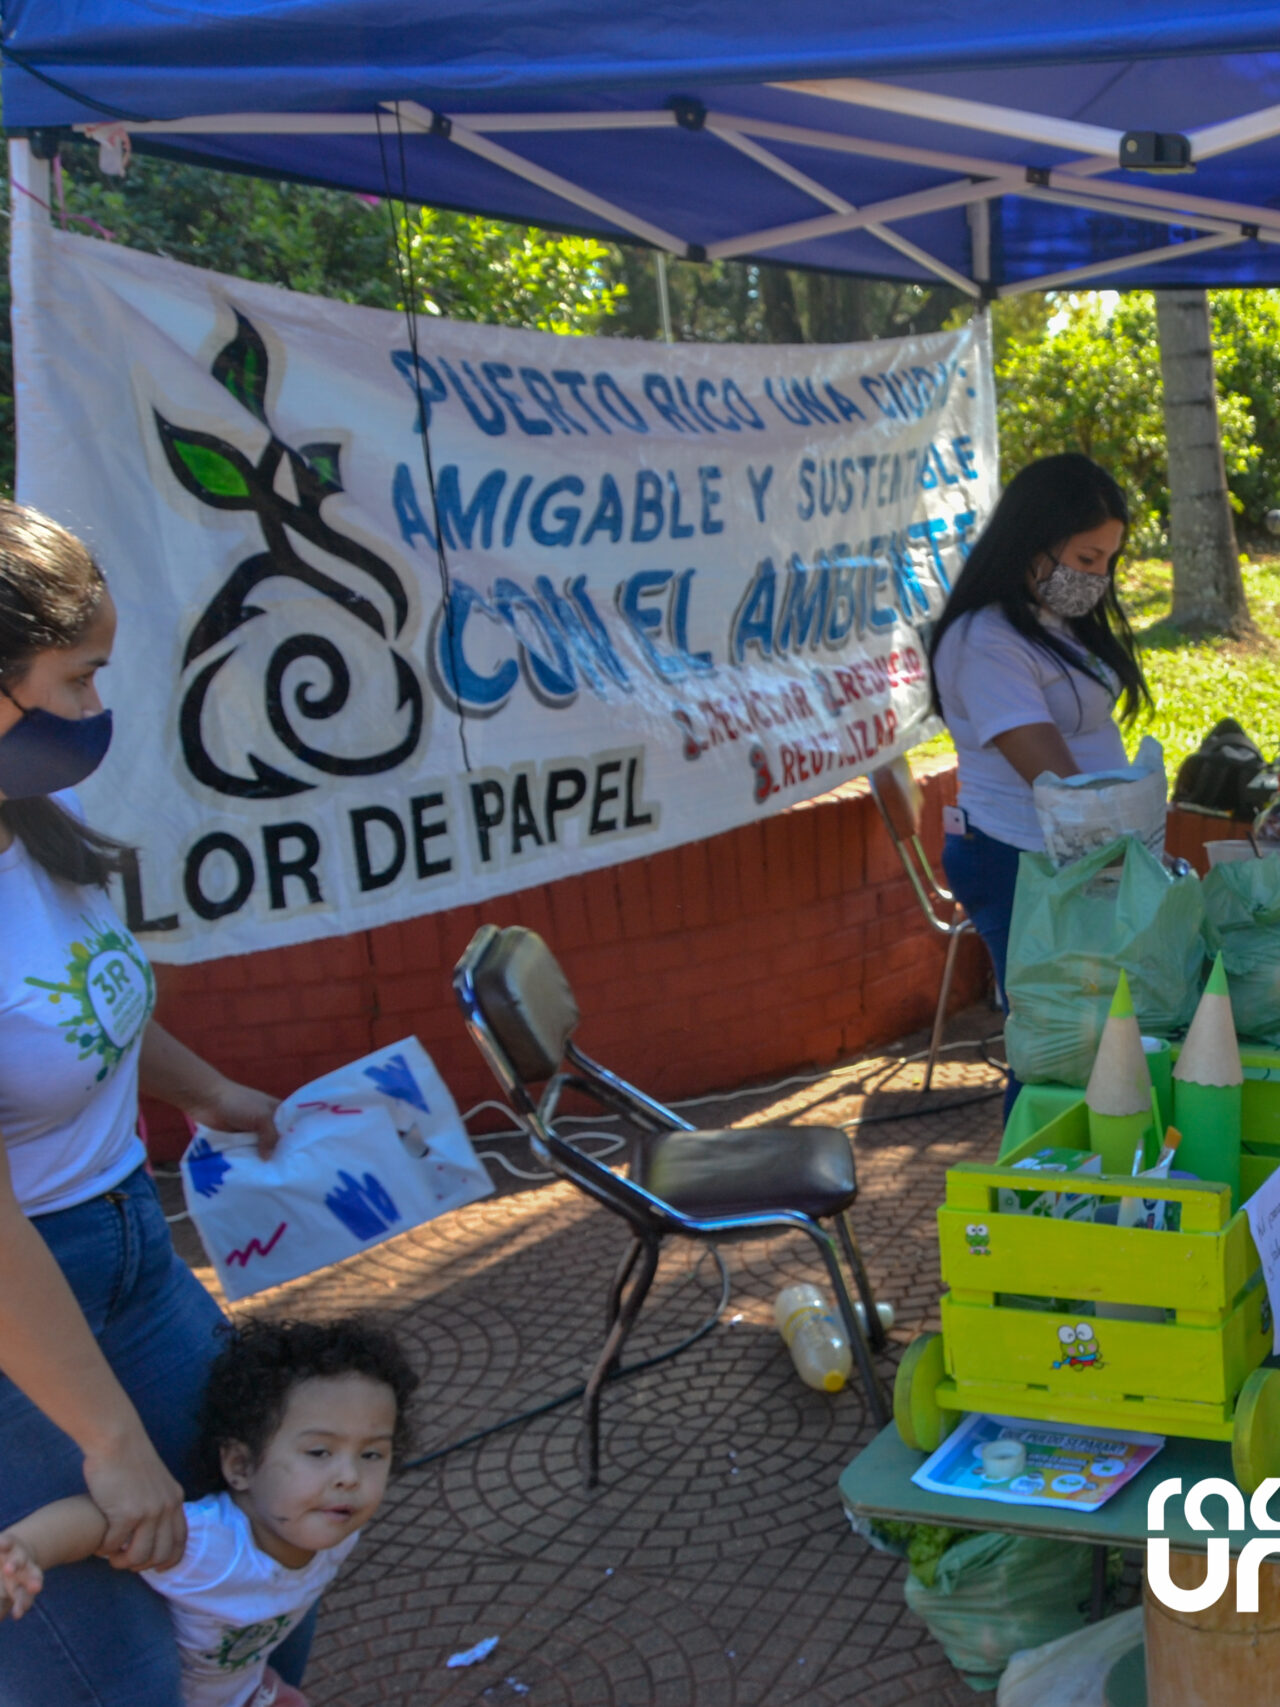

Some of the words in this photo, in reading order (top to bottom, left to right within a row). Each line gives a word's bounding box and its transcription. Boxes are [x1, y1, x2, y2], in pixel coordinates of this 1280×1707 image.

[391, 349, 649, 437] PUERTO
[642, 373, 766, 434] RICO
[764, 377, 866, 426] UNA
[391, 462, 725, 551] AMIGABLE
[746, 464, 774, 523] Y
[614, 566, 718, 684] EL
[119, 822, 325, 932] LOR
[349, 792, 453, 893] DE
[469, 757, 654, 863] PAPEL
[91, 958, 131, 1005] 3R
